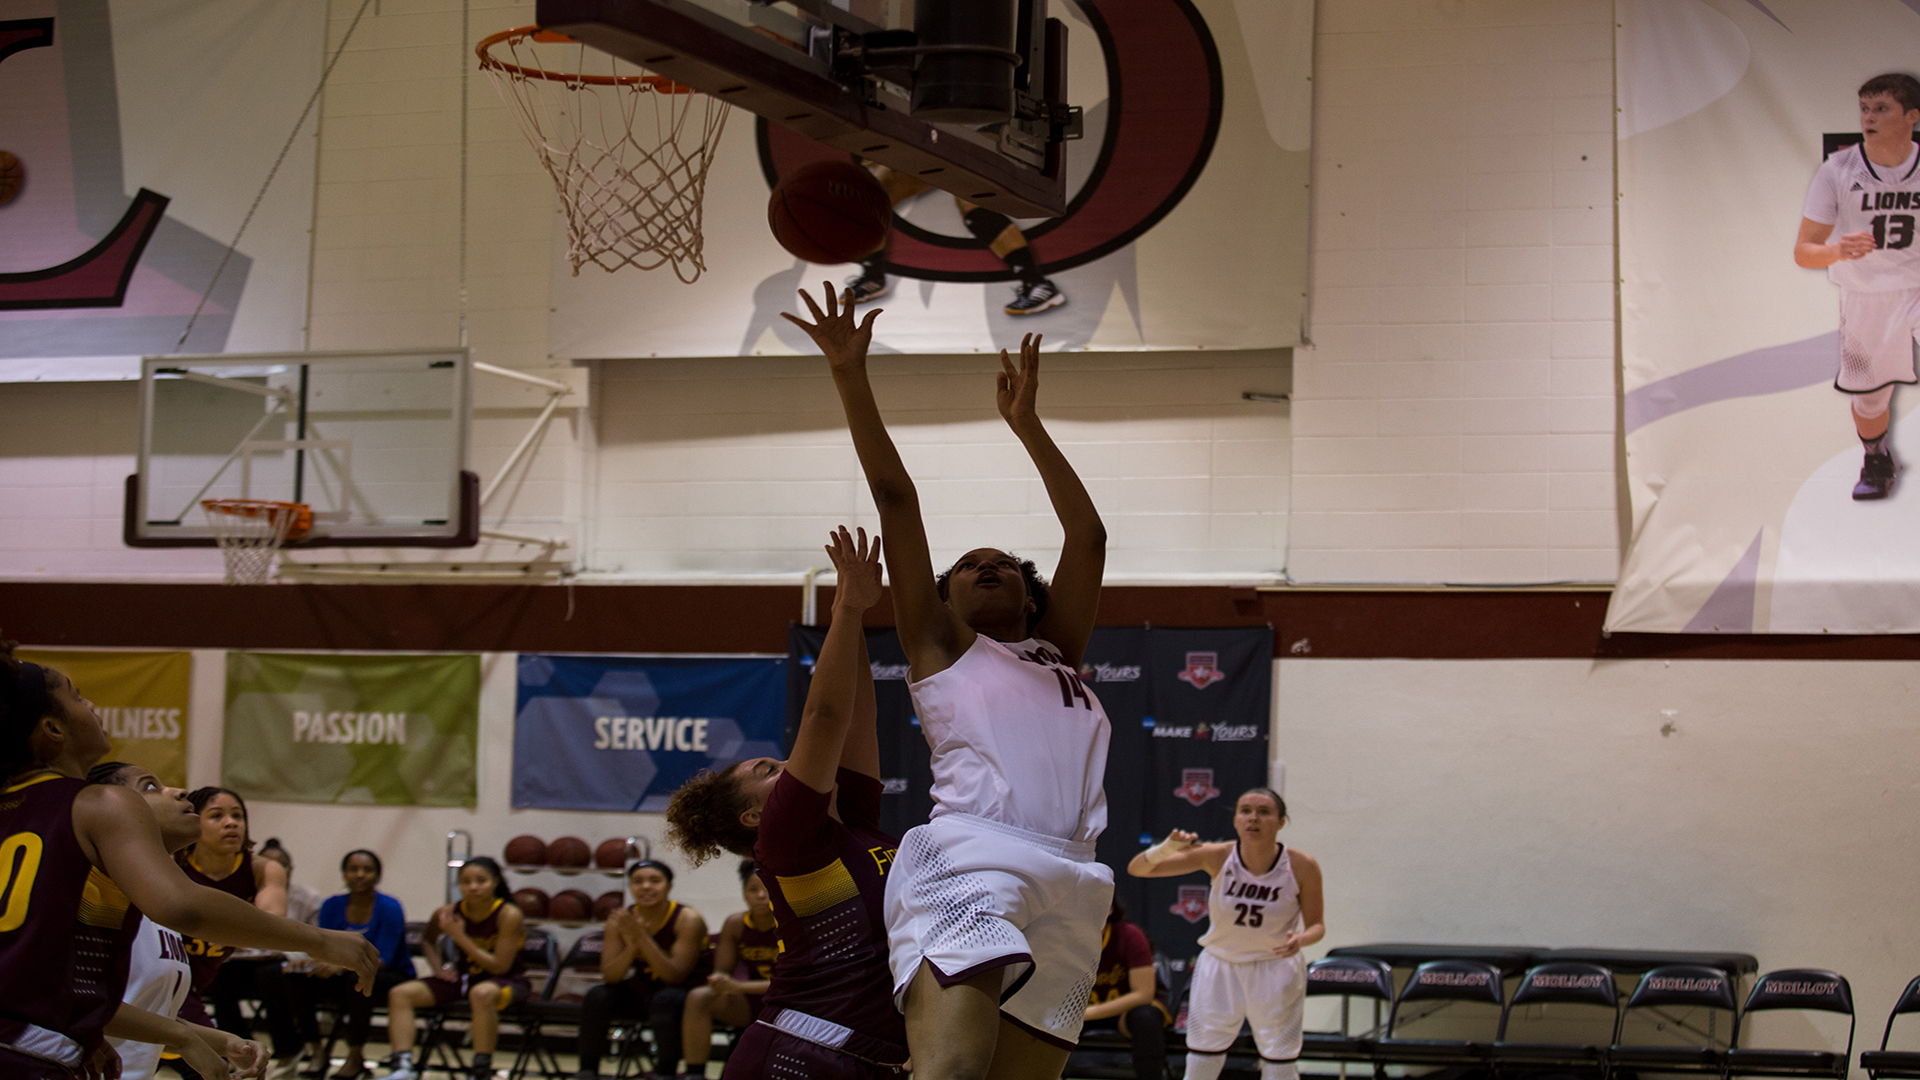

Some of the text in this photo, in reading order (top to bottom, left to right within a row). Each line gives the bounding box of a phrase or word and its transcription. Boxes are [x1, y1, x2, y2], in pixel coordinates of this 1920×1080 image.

[1871, 214, 1915, 250] 13
[1051, 667, 1092, 711] 14
[293, 711, 407, 745] PASSION
[594, 716, 710, 753] SERVICE
[1152, 725, 1193, 738] MAKE
[1225, 880, 1283, 902] LIONS
[1234, 903, 1266, 928] 25
[1308, 968, 1380, 983] MOLLOY
[1419, 971, 1491, 987] MOLLOY
[1532, 974, 1604, 989] MOLLOY
[1648, 976, 1722, 992] MOLLOY
[1765, 980, 1839, 995] MOLLOY
